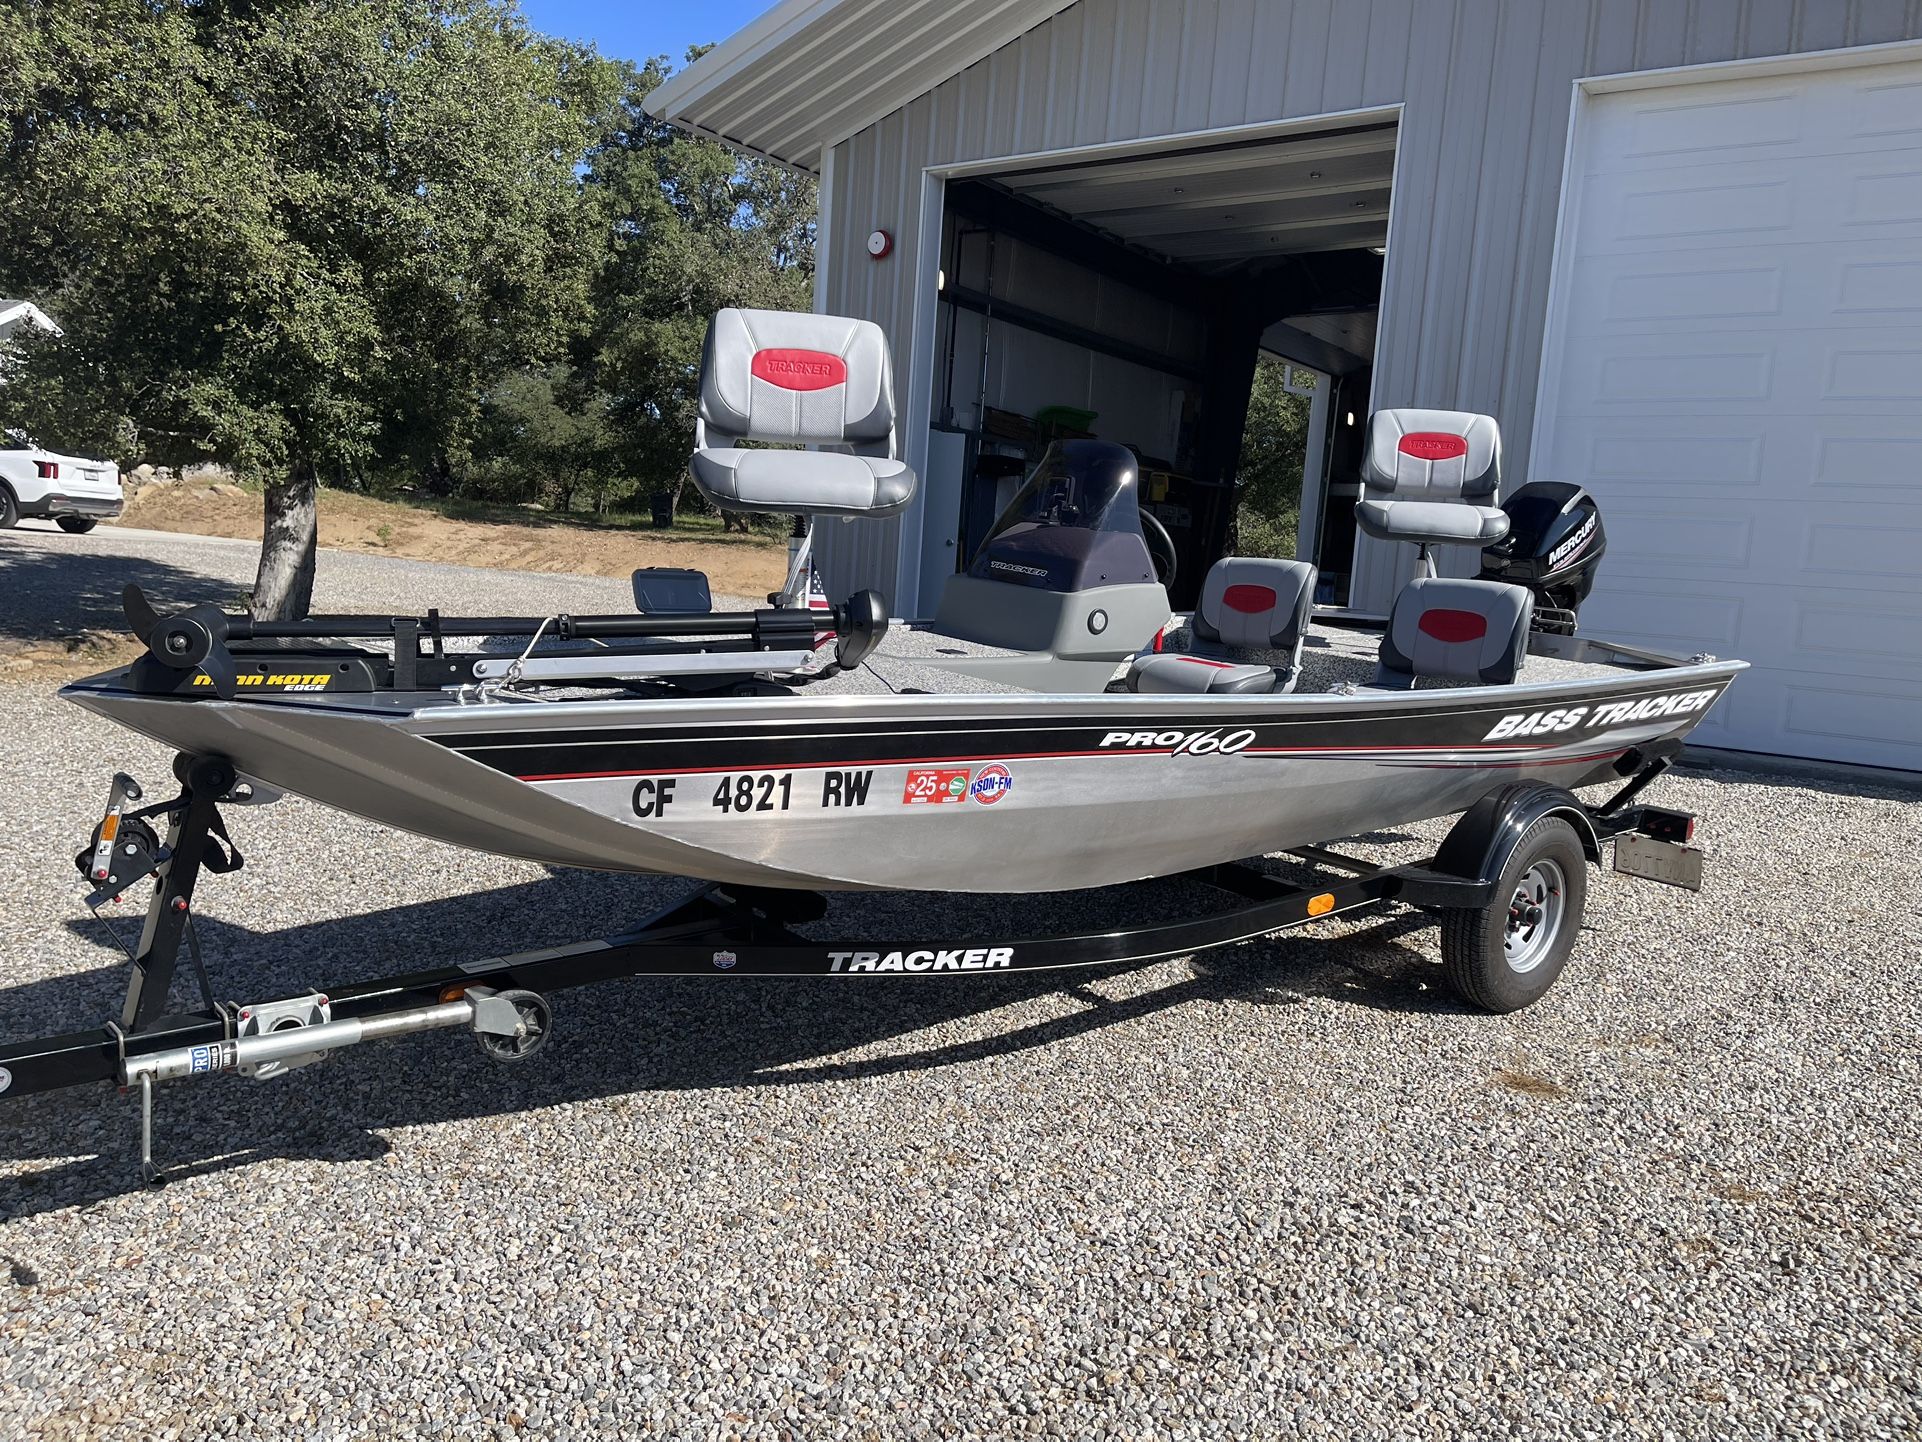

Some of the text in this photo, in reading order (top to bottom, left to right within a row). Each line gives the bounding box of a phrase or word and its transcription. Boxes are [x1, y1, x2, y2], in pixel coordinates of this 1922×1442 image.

[766, 360, 831, 375] TRACKER
[1409, 440, 1456, 450] TRACKER
[1548, 511, 1596, 566] MERCURY
[990, 560, 1048, 576] TRACKER
[266, 674, 332, 686] KOTA
[283, 684, 327, 692] EDGE
[1481, 689, 1718, 742] BASS TRACKER
[632, 770, 873, 818] CF 4821 RW
[914, 776, 938, 796] 25
[970, 776, 1013, 795] KSON-FM
[826, 947, 1015, 972] TRACKER
